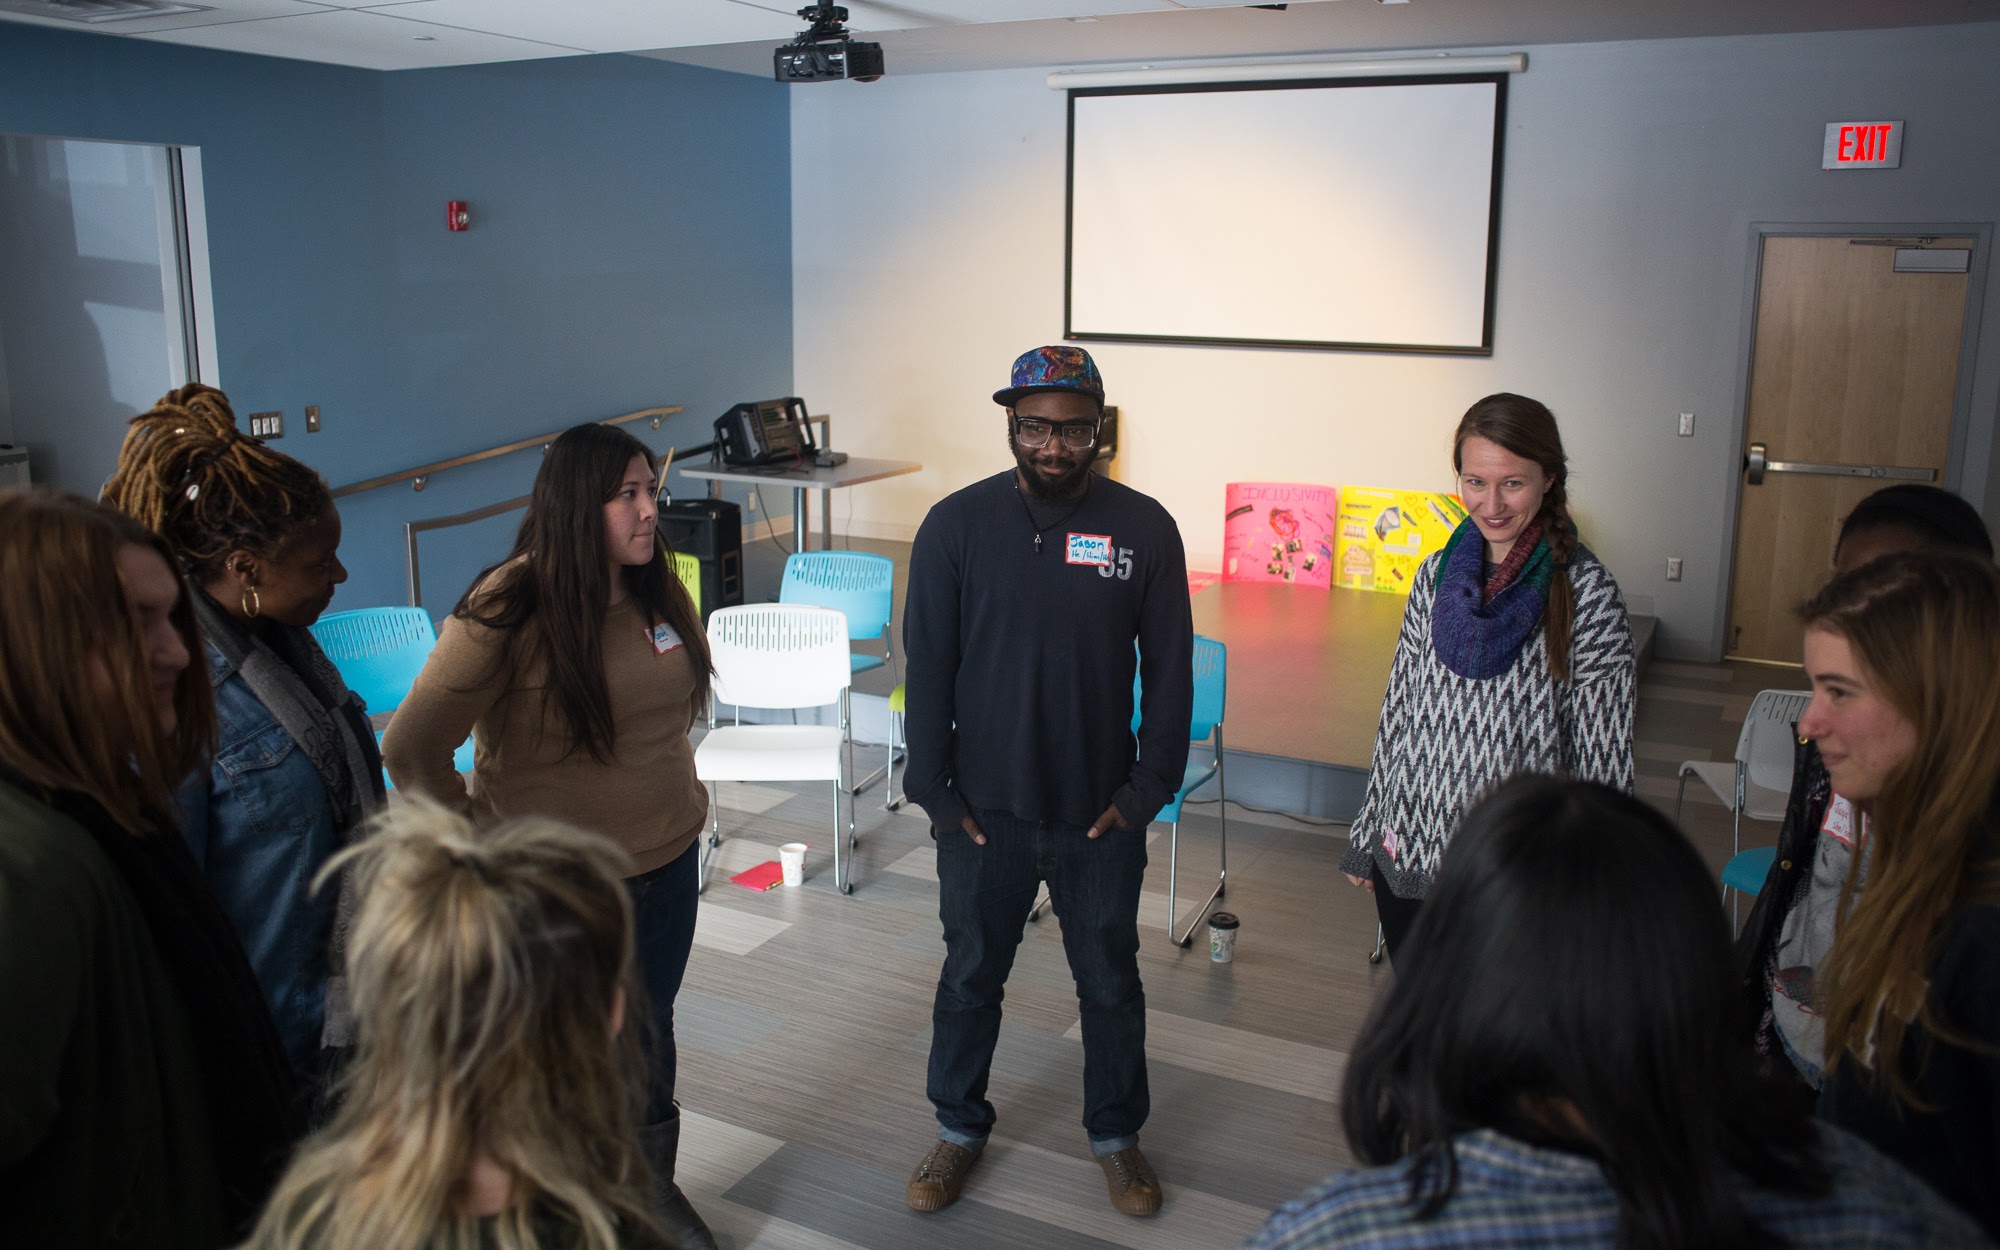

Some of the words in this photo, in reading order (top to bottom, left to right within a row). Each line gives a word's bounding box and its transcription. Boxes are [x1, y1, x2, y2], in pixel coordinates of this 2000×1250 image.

[1837, 124, 1893, 162] EXIT
[1242, 486, 1330, 505] INCLUSIVITY
[1070, 535, 1104, 551] Jason
